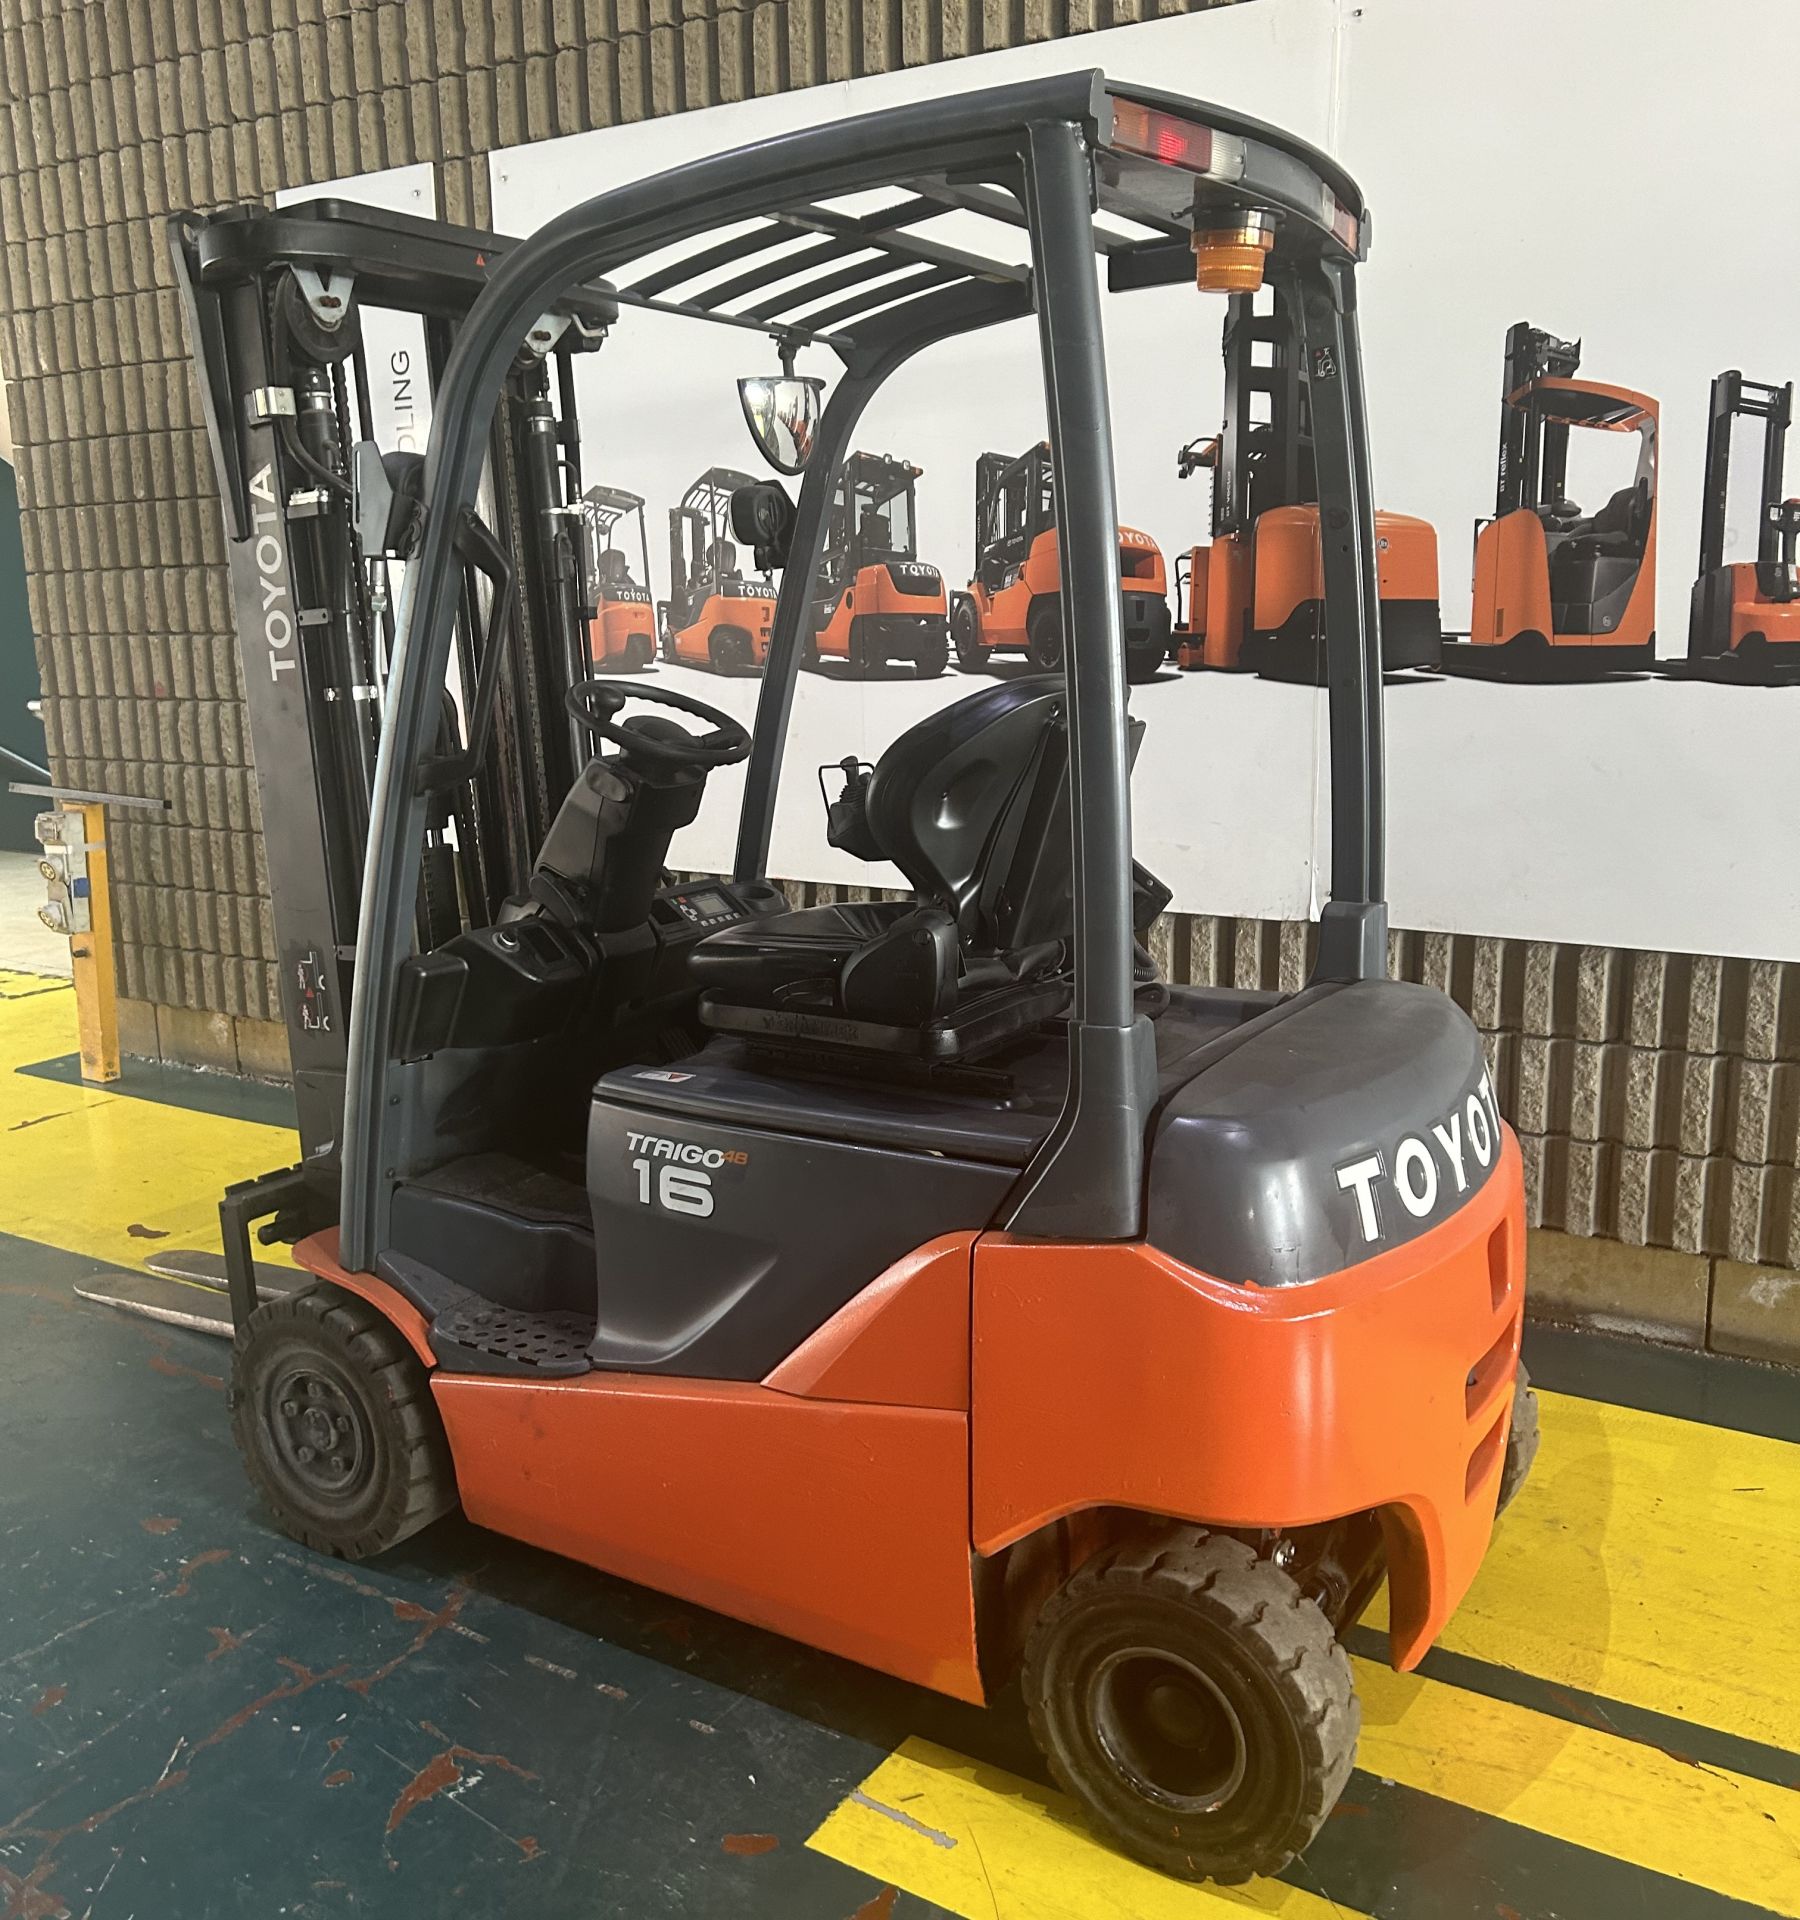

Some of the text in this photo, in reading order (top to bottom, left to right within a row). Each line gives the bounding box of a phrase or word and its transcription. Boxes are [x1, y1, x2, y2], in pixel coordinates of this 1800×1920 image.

[249, 464, 295, 682] TOYOTA
[616, 590, 650, 601] TOYOTA
[632, 1158, 714, 1218] 16
